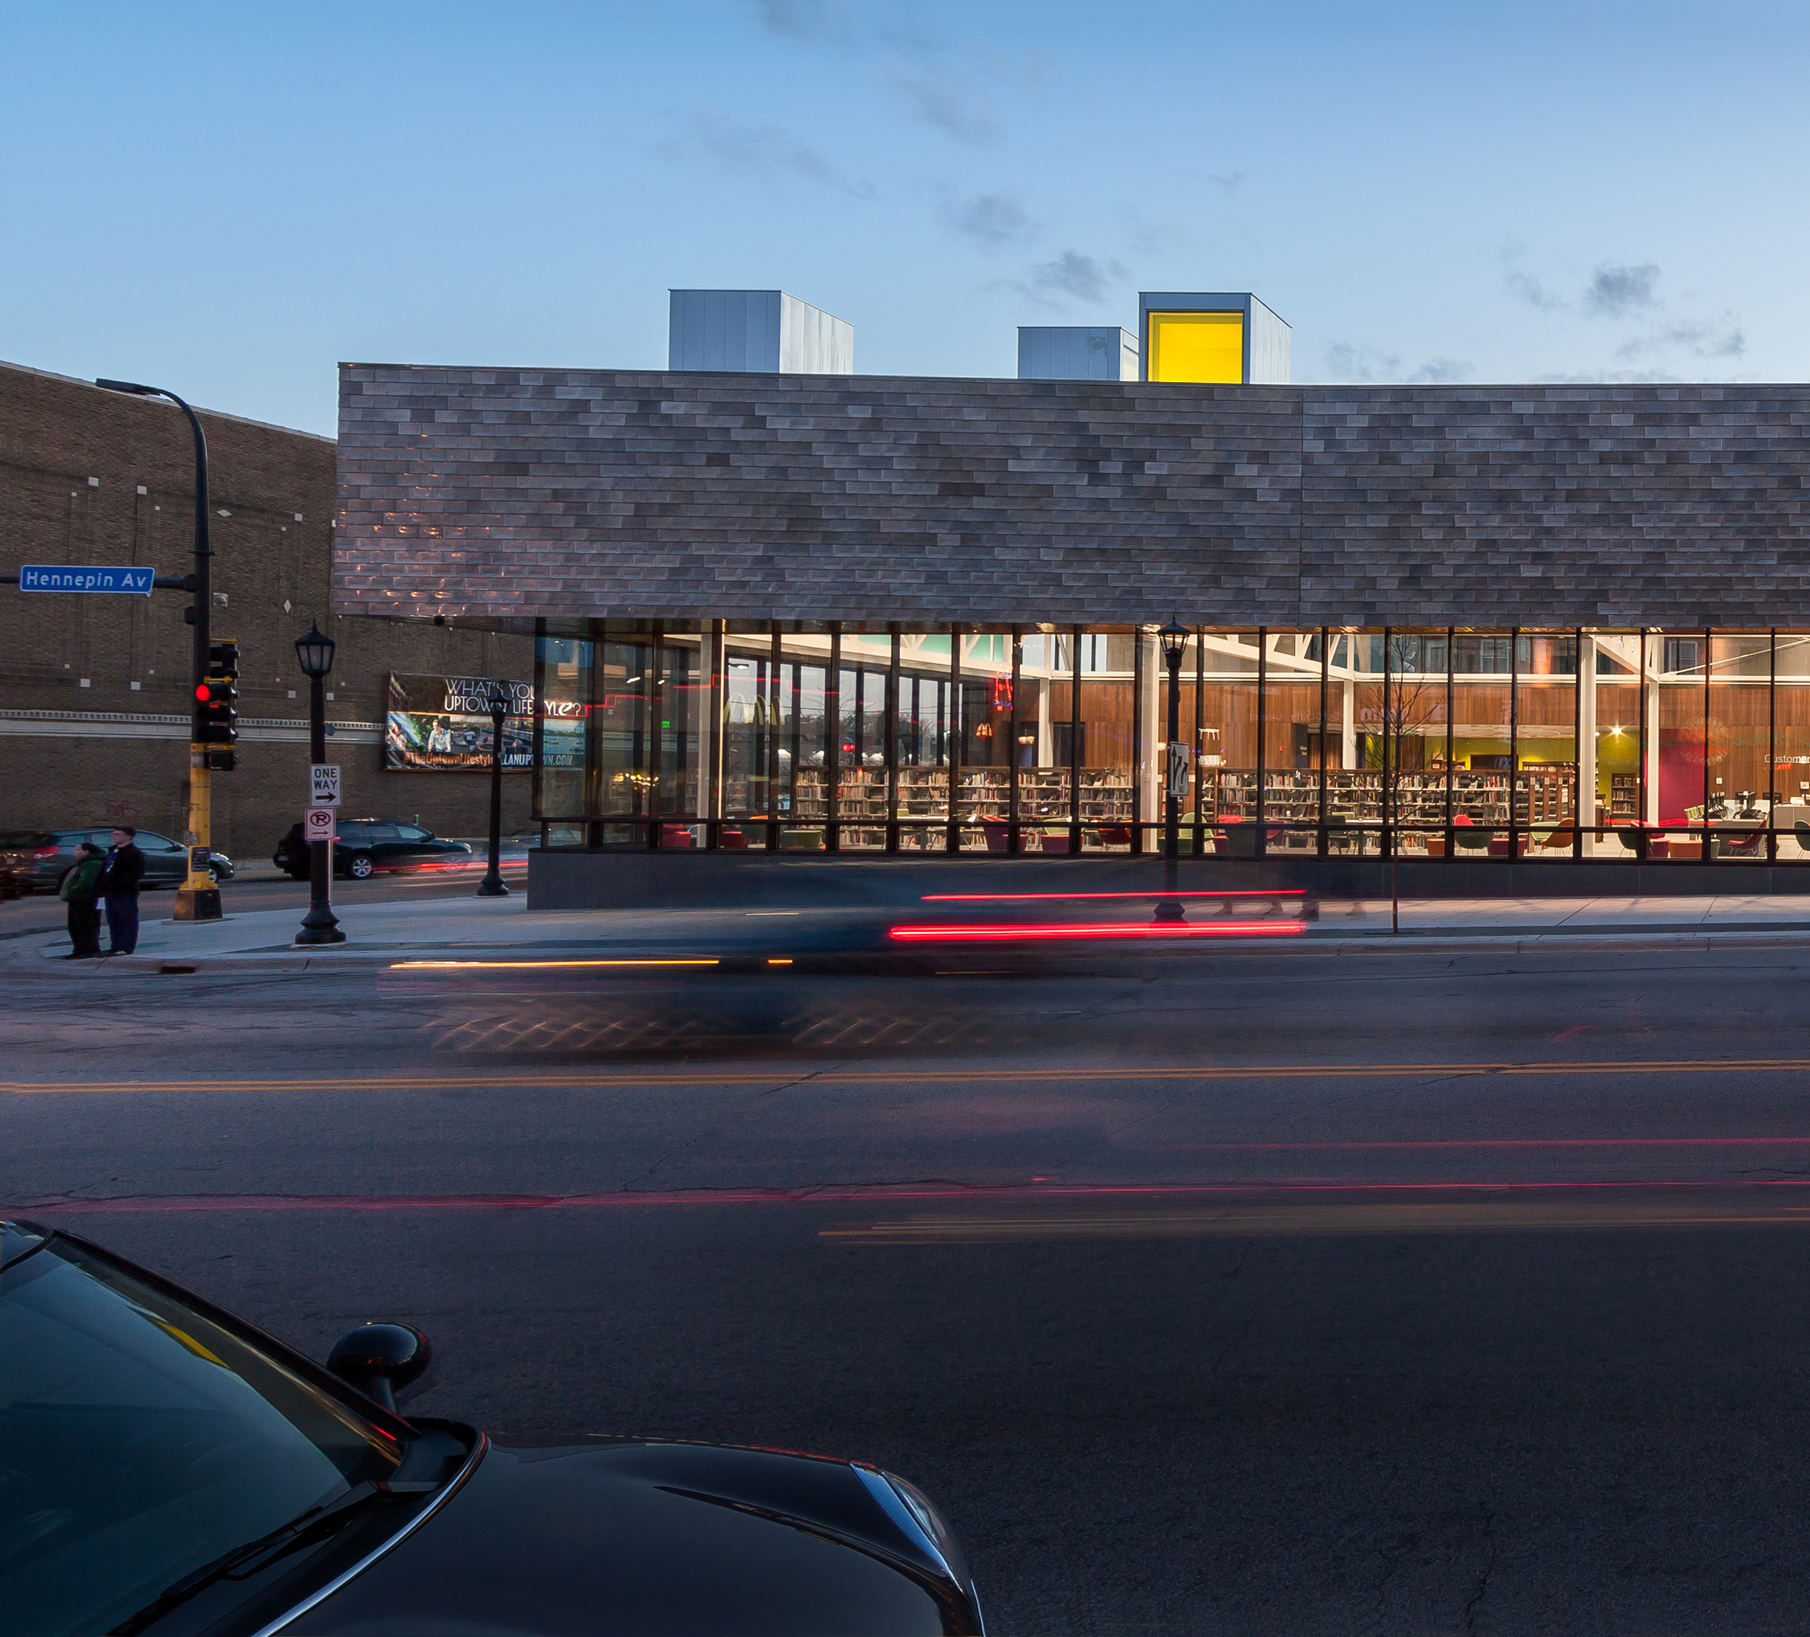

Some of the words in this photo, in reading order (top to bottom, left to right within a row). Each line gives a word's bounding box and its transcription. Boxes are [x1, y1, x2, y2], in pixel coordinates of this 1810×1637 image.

[26, 571, 114, 589] Hennepin
[121, 573, 147, 587] Av
[314, 768, 337, 778] ONE
[313, 780, 338, 790] WAY
